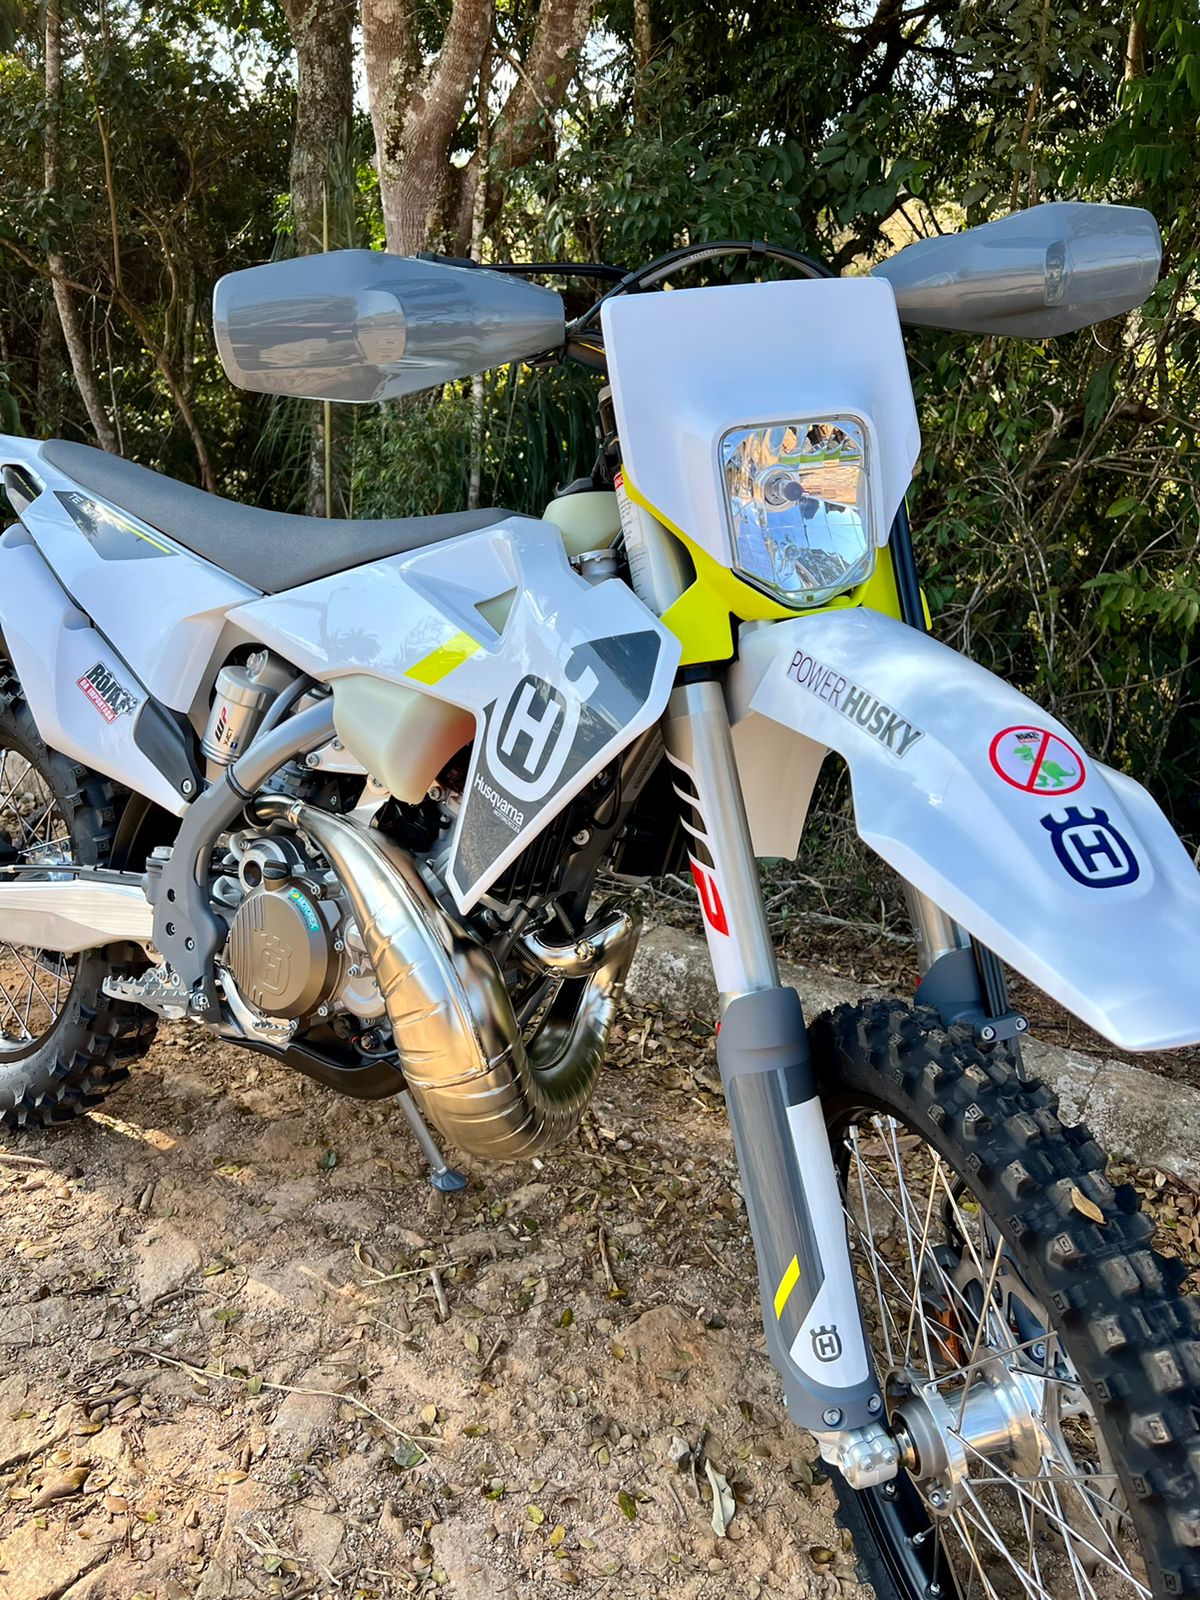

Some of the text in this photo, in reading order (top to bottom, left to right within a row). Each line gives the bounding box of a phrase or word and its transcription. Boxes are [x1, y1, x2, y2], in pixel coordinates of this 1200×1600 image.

[214, 705, 229, 742] WP
[787, 650, 922, 756] POWER HUSKY
[500, 682, 561, 775] H
[474, 773, 524, 826] Husqvarna
[493, 808, 522, 834] MOTORCYCLES
[1068, 829, 1123, 873] H
[295, 895, 319, 930] MOTOREX
